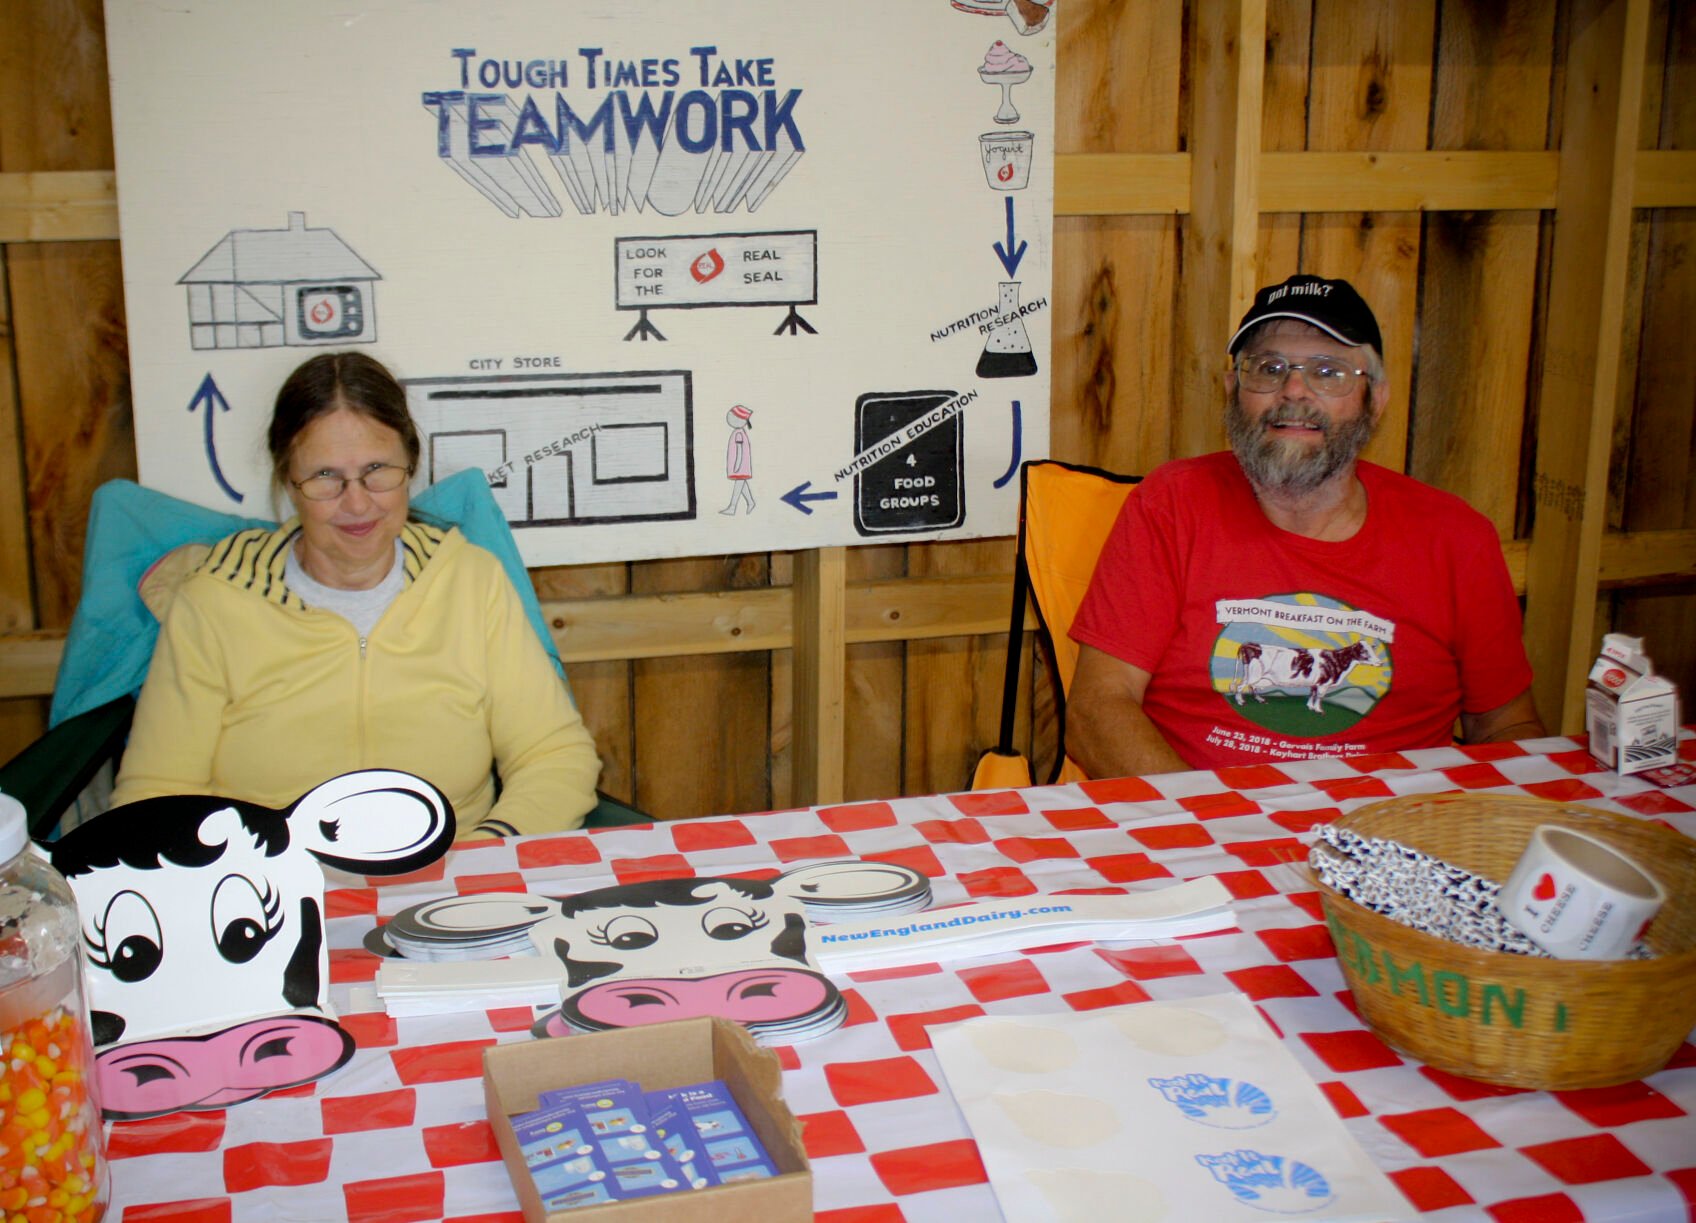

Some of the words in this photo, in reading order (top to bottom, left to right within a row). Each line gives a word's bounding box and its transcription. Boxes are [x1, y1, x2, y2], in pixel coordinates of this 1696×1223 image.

[451, 48, 567, 88] TOUGH
[578, 47, 680, 88] TIMES
[690, 45, 775, 87] TAKE
[421, 89, 806, 158] TEAMWORK
[626, 247, 668, 260] LOOK
[742, 249, 781, 262] REAL
[633, 267, 663, 280] FOR
[743, 271, 783, 284] SEAL
[634, 283, 663, 297] THE
[1267, 285, 1288, 305] got
[1291, 282, 1333, 297] milk?
[930, 304, 1000, 342] NUTRITION
[978, 297, 1048, 336] RESEARCH
[469, 359, 503, 370] CITY
[513, 356, 561, 368] STORE
[833, 436, 902, 482] NUTRITION
[906, 388, 979, 440] EDUCATION
[487, 460, 515, 484] KET
[523, 422, 602, 467] RESEARCH
[906, 453, 917, 467] 4
[894, 476, 936, 490] FOOD
[879, 494, 940, 509] GROUPS
[1225, 606, 1272, 617] VERMONT
[1274, 610, 1324, 624] BREAKFAST
[1326, 616, 1344, 626] ON
[1346, 617, 1363, 627] THE
[1363, 622, 1388, 635] FARM
[1206, 735, 1223, 747] July
[1239, 742, 1261, 754] 2018
[1212, 726, 1231, 738] June
[1249, 735, 1271, 746] 2018
[1315, 743, 1343, 753] Family
[1344, 743, 1366, 751] Farm
[1540, 883, 1577, 934] CHEESE
[820, 904, 1074, 945] NewEnglandDairy.com
